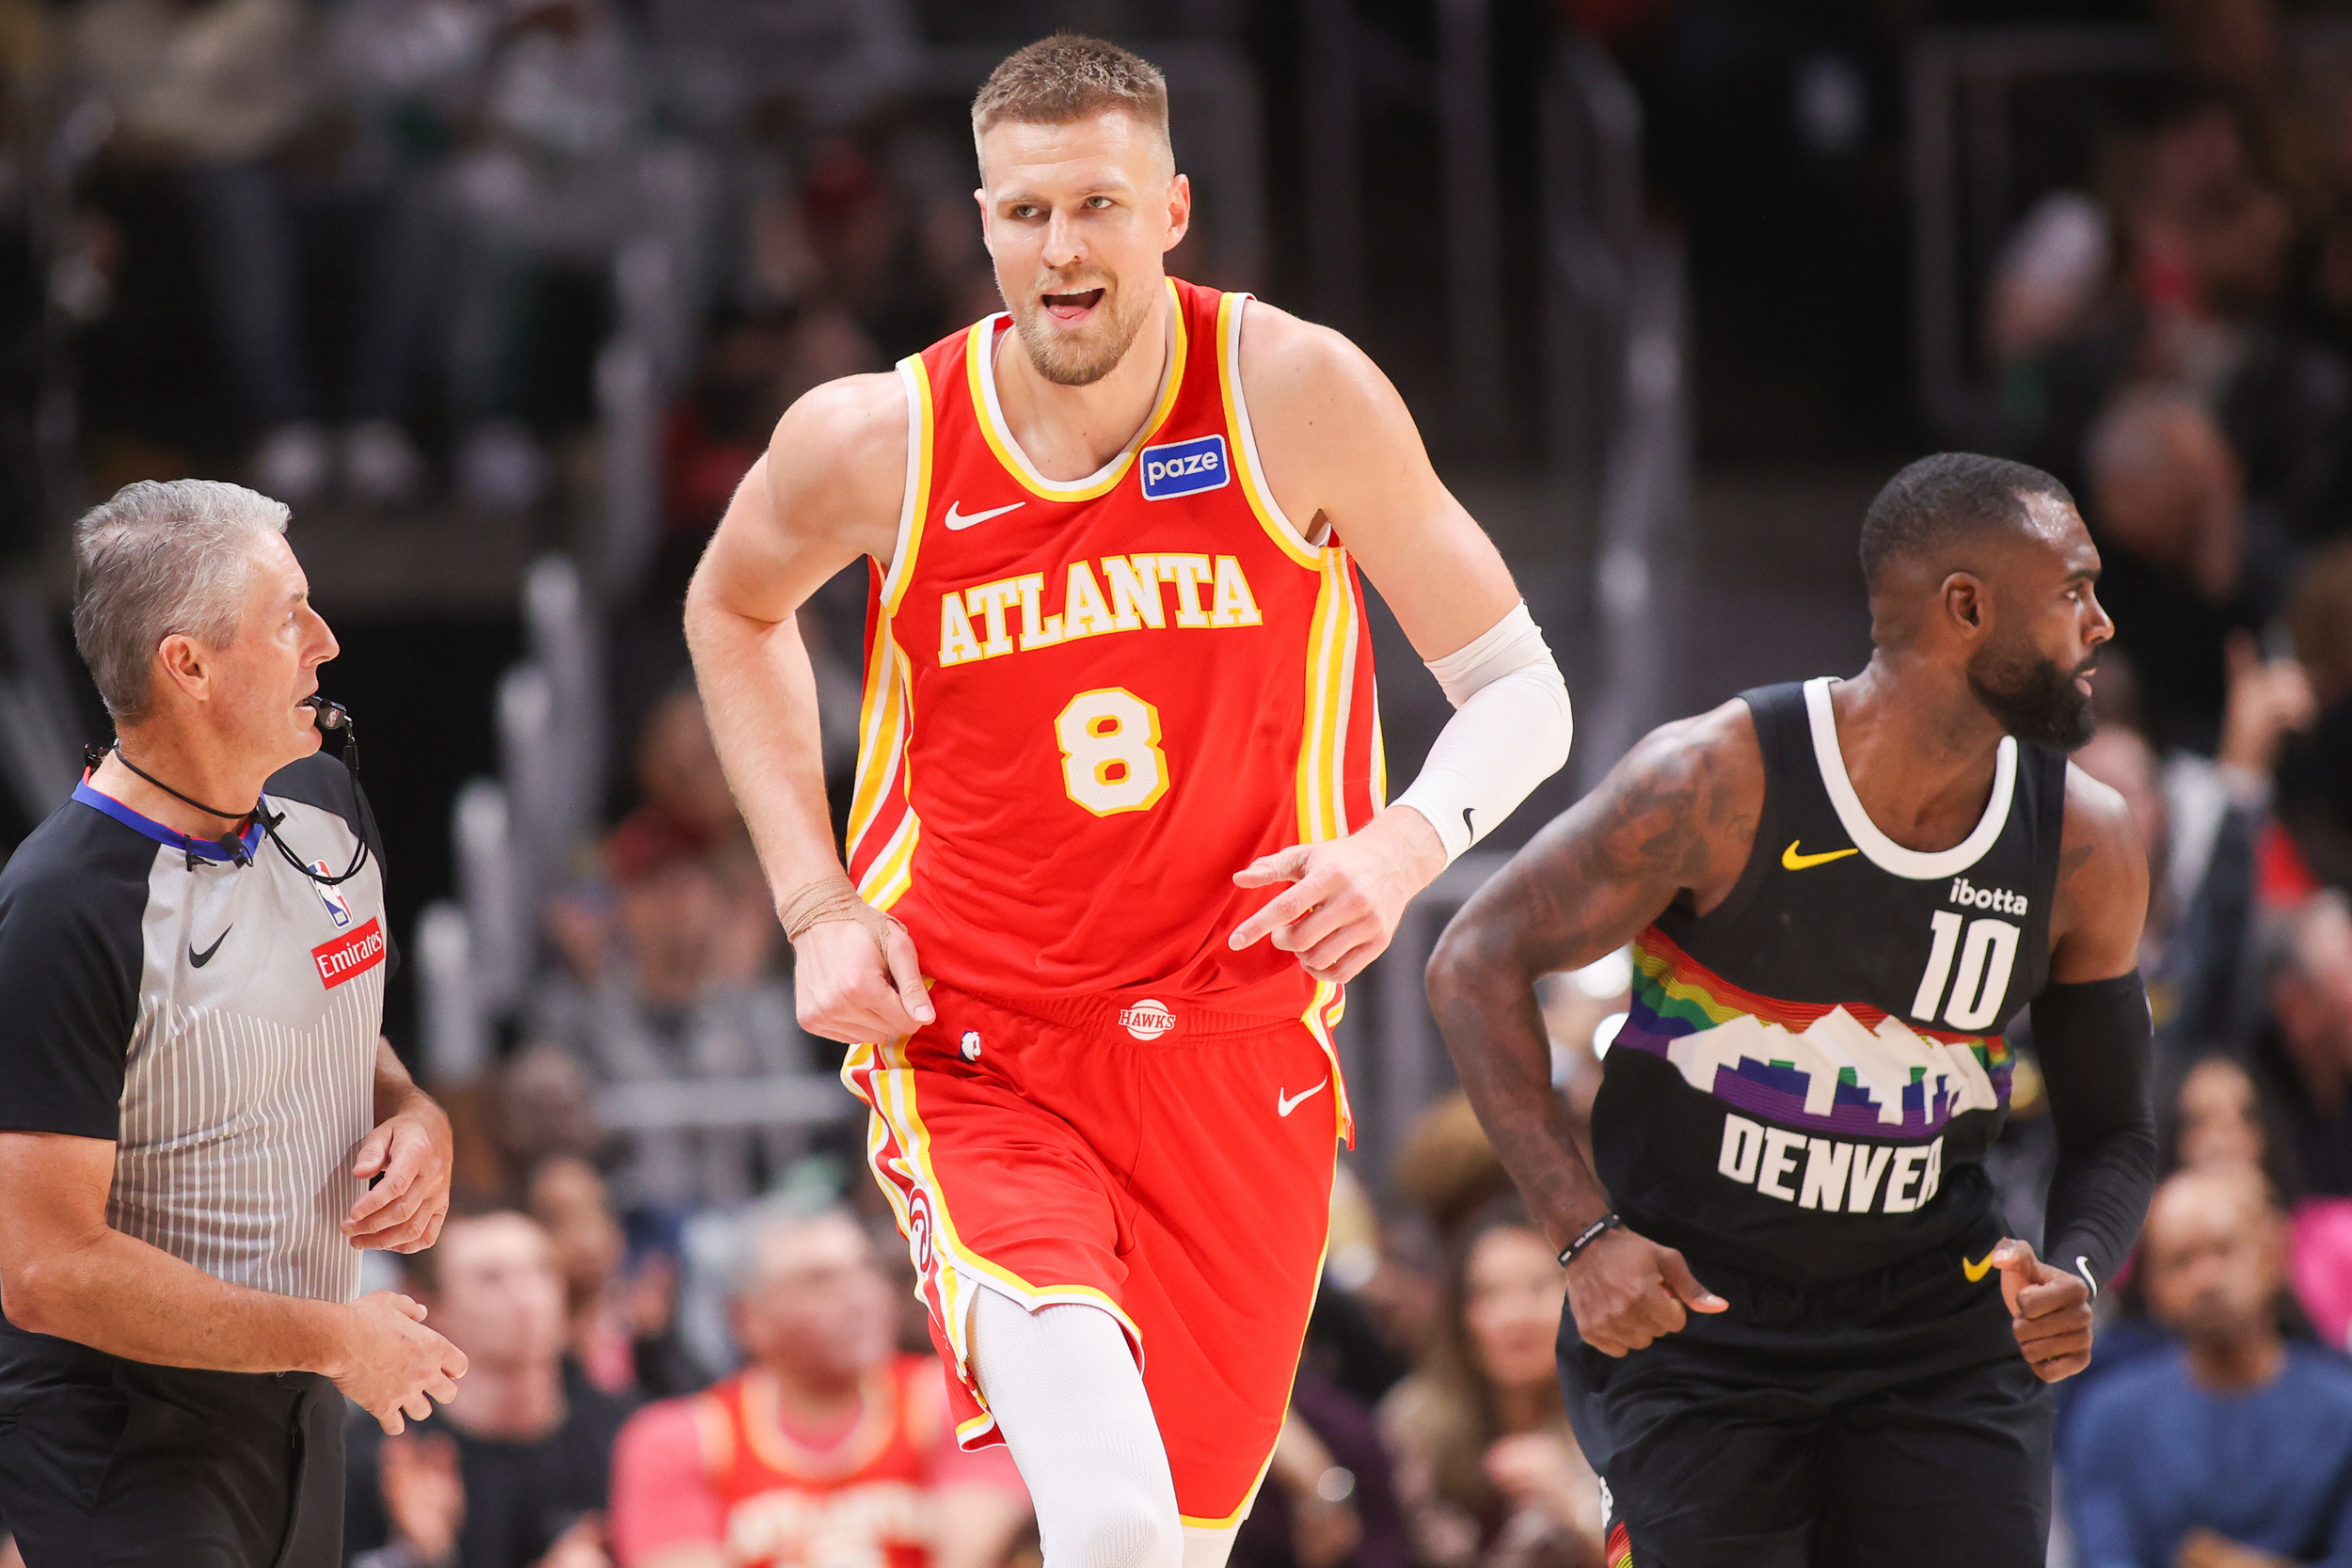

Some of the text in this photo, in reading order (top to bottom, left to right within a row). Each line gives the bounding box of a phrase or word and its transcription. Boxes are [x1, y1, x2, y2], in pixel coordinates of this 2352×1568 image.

[1148, 451, 1218, 486] paze
[938, 553, 1263, 668] ATLANTA
[1054, 687, 1170, 817] 8
[1949, 878, 2028, 916] ibotta
[316, 930, 382, 978] Emirates
[1911, 910, 2021, 1031] 10
[1120, 1009, 1176, 1029] HAWKS
